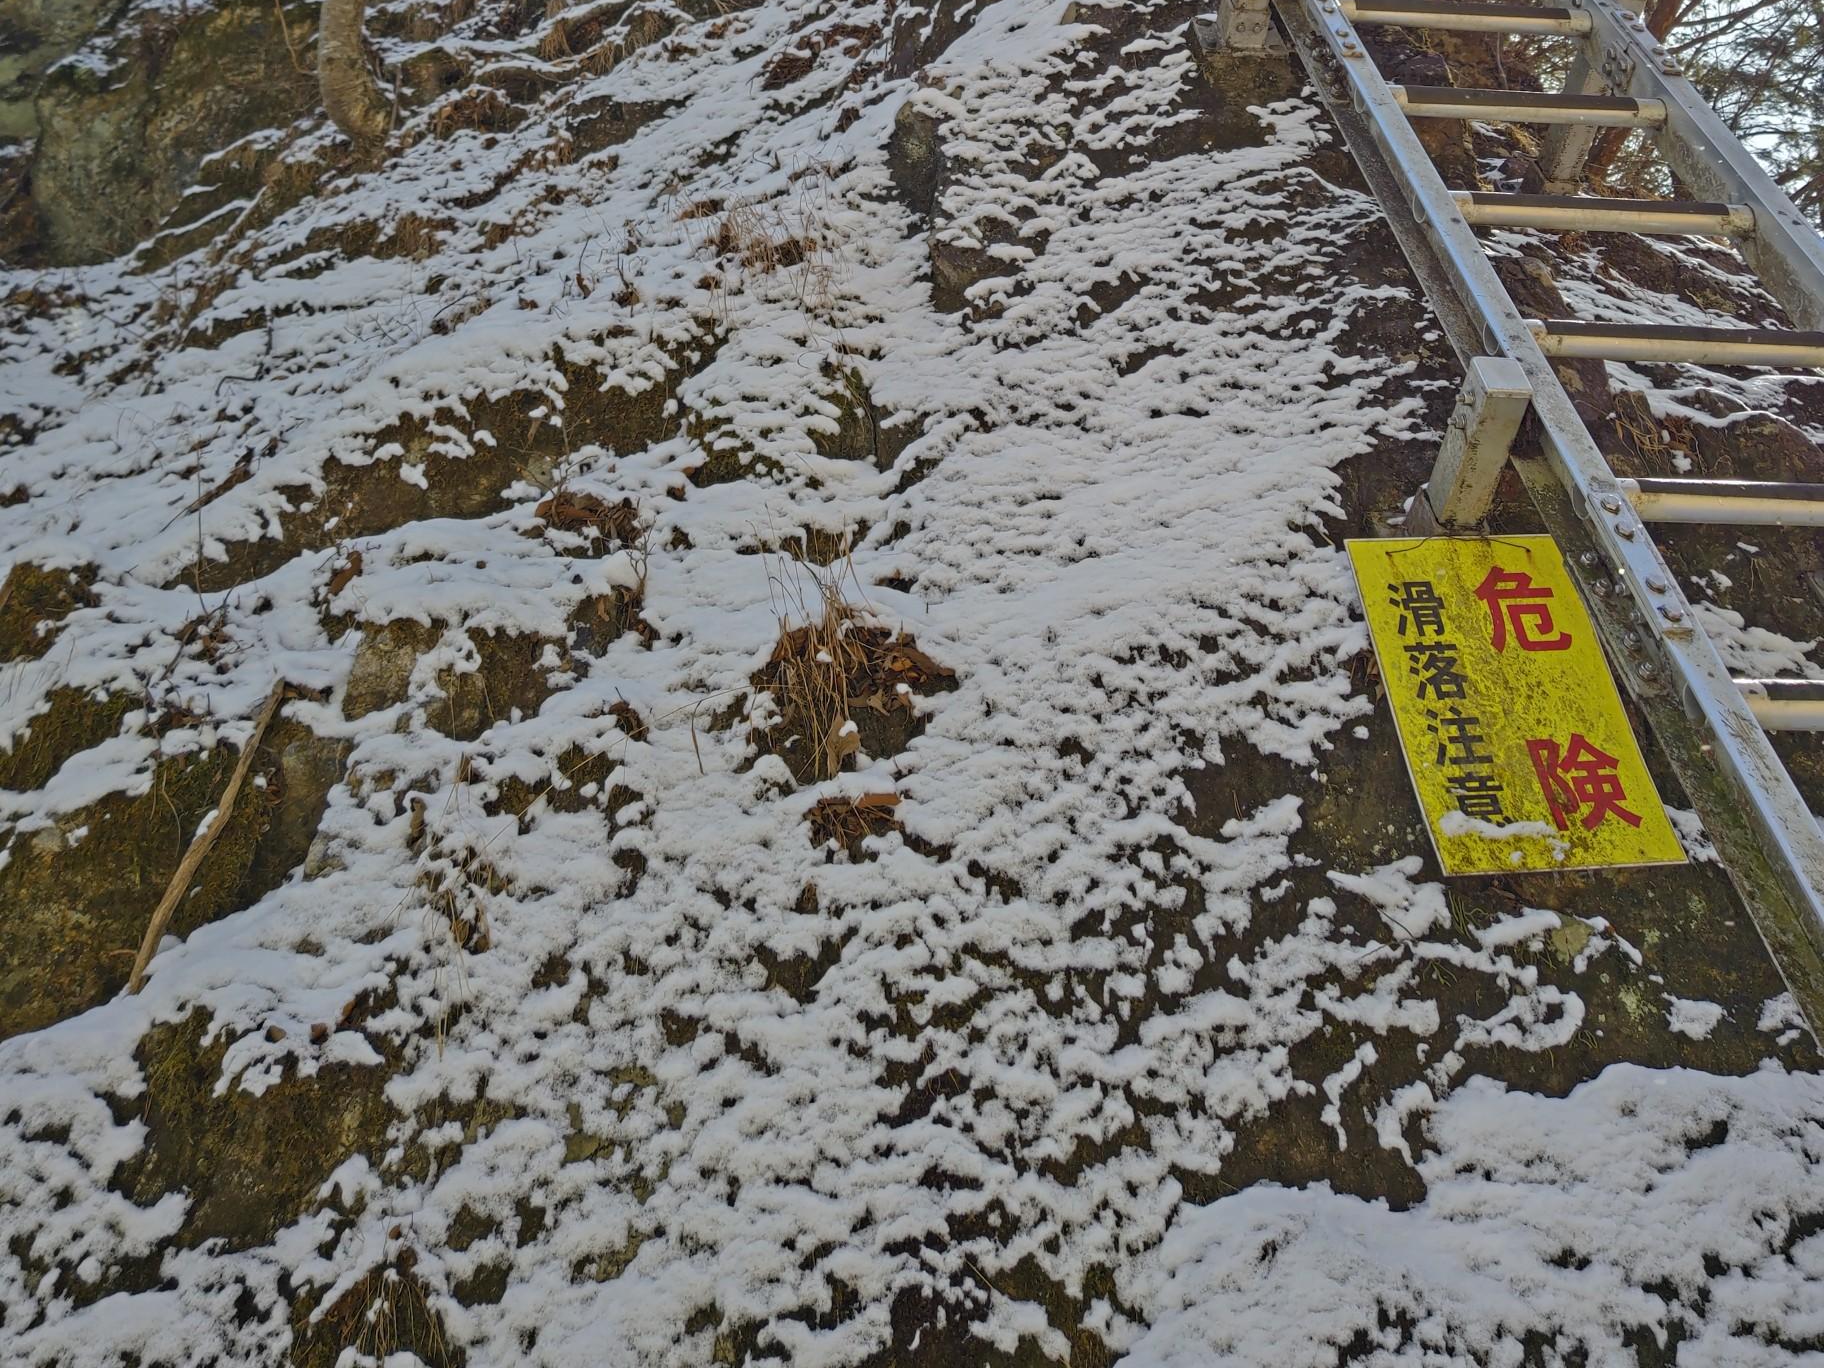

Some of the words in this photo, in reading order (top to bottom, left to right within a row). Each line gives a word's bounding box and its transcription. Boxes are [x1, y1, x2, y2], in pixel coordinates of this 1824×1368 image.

[1387, 580, 1511, 827] 滑落注意
[1474, 566, 1643, 831] 危険
